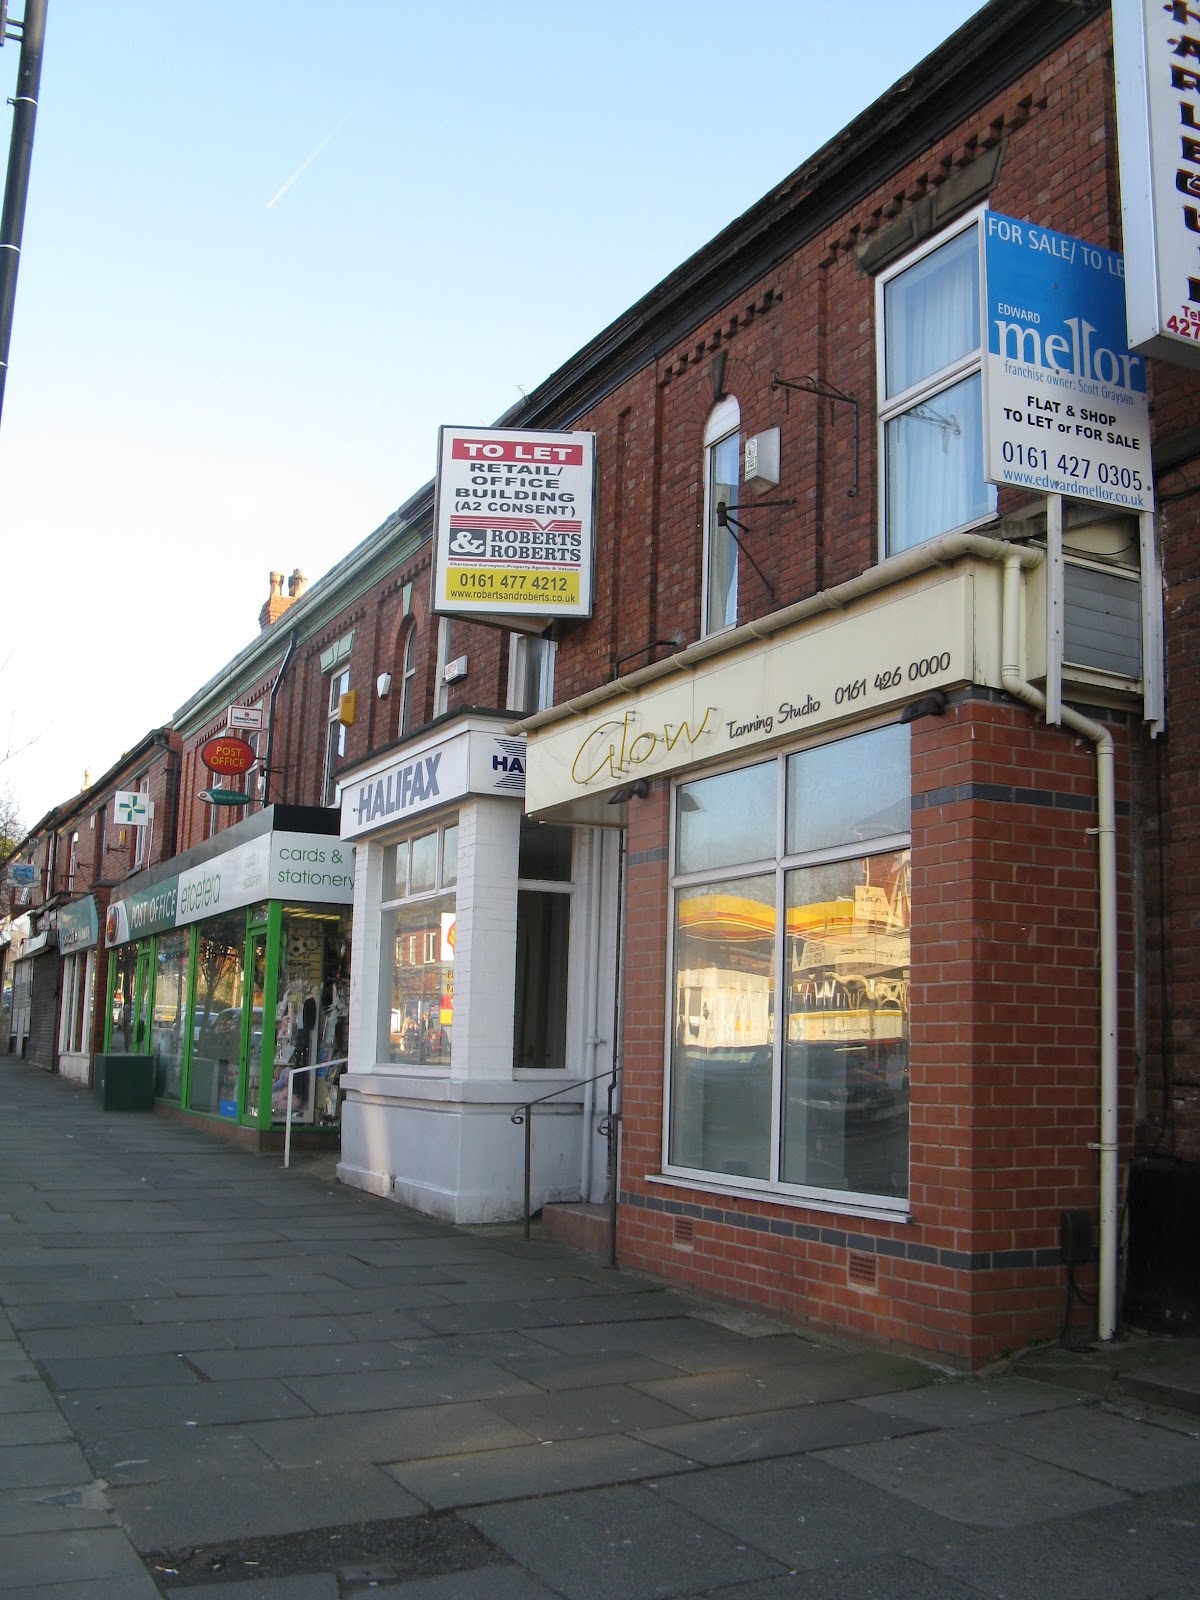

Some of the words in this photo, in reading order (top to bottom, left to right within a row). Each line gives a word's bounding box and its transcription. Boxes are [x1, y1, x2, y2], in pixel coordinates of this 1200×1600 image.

[988, 217, 1022, 245] FOR
[1028, 230, 1075, 264] SALE/
[1081, 247, 1102, 269] TO
[1108, 256, 1125, 278] LE
[998, 303, 1040, 324] EDWARD
[994, 317, 1139, 390] mellor
[1005, 360, 1044, 383] franchise
[1047, 374, 1076, 391] owner:
[1078, 379, 1099, 397] Scott
[1101, 386, 1133, 406] Grayson
[1027, 395, 1060, 413] FLAT
[1066, 405, 1075, 417] &
[1080, 408, 1116, 427] SHOP
[1004, 408, 1022, 423] TO
[1027, 414, 1053, 429] LET
[1058, 423, 1071, 434] or
[1075, 425, 1103, 441] FOR
[1107, 432, 1140, 450] SALE
[463, 442, 504, 458] TO
[515, 445, 572, 461] LET
[470, 463, 563, 476] RETAIL/
[1002, 441, 1047, 470] 0161
[1057, 454, 1090, 479] 427
[1098, 463, 1142, 491] 0305
[471, 475, 560, 489] OFFICE
[1003, 470, 1144, 507] www.edwardmellor.co.uk
[455, 488, 575, 502] BUILDING
[455, 501, 482, 513] (A2
[487, 502, 576, 517] CONSENT)
[450, 531, 485, 553] &
[490, 530, 582, 546] ROBERTS
[489, 545, 581, 562] ROBERTS
[460, 573, 494, 587] 0161
[500, 575, 526, 589] 477
[532, 577, 567, 591] 4212
[450, 589, 575, 603] www.robertsandroberts.co.uk
[726, 715, 773, 739] Tanning
[778, 694, 821, 724] Studio
[835, 678, 866, 704] 0161
[874, 666, 902, 691] 426
[908, 651, 950, 681] 0000
[210, 756, 245, 767] OFFICE
[216, 746, 242, 757] POST
[358, 751, 442, 826] HALIFAX
[280, 848, 326, 863] cards
[331, 849, 343, 864] &
[278, 868, 354, 890] stationery
[180, 872, 221, 914] etcetera
[131, 901, 148, 930] POST
[150, 889, 177, 922] OFFICE
